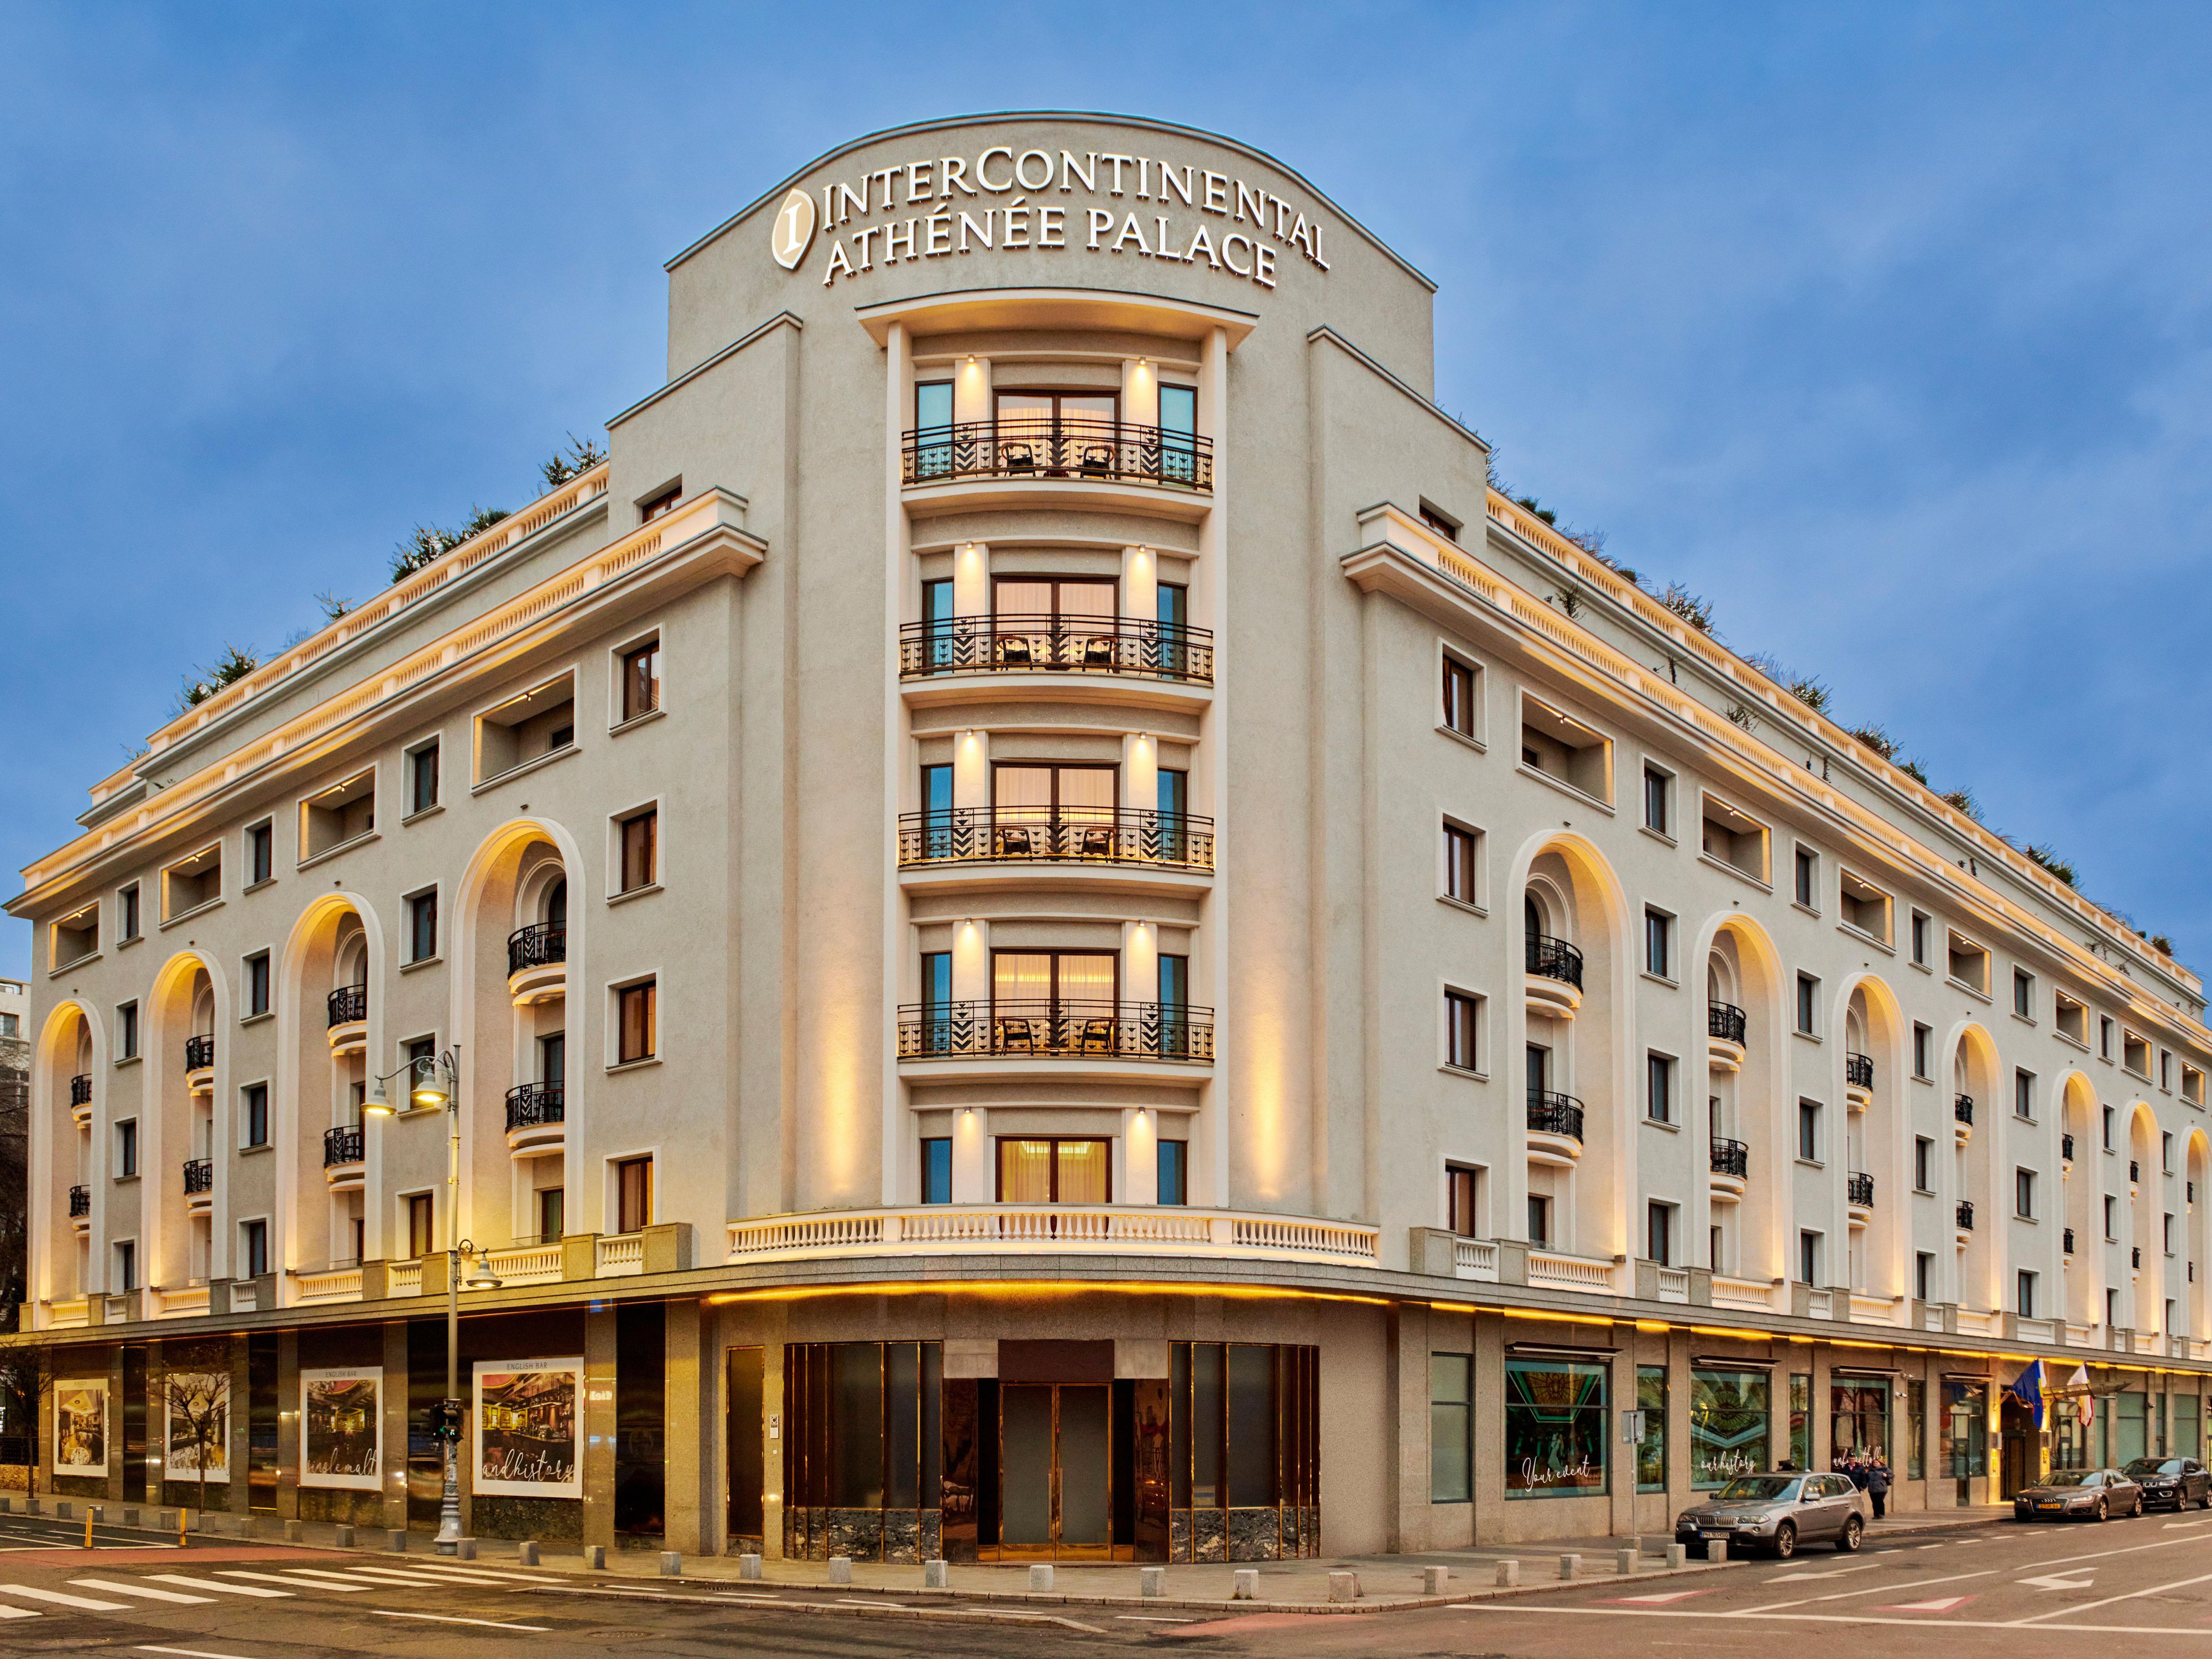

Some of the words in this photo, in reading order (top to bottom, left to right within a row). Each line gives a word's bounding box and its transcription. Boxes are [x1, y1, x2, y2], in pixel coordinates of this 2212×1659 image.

[822, 146, 1331, 270] INTERCONTINENTAL
[822, 196, 1066, 285] ATHÉNÉE
[1086, 207, 1277, 288] PALACE
[343, 1448, 377, 1476] malt
[1522, 1455, 1555, 1492] Your
[1556, 1454, 1590, 1477] event
